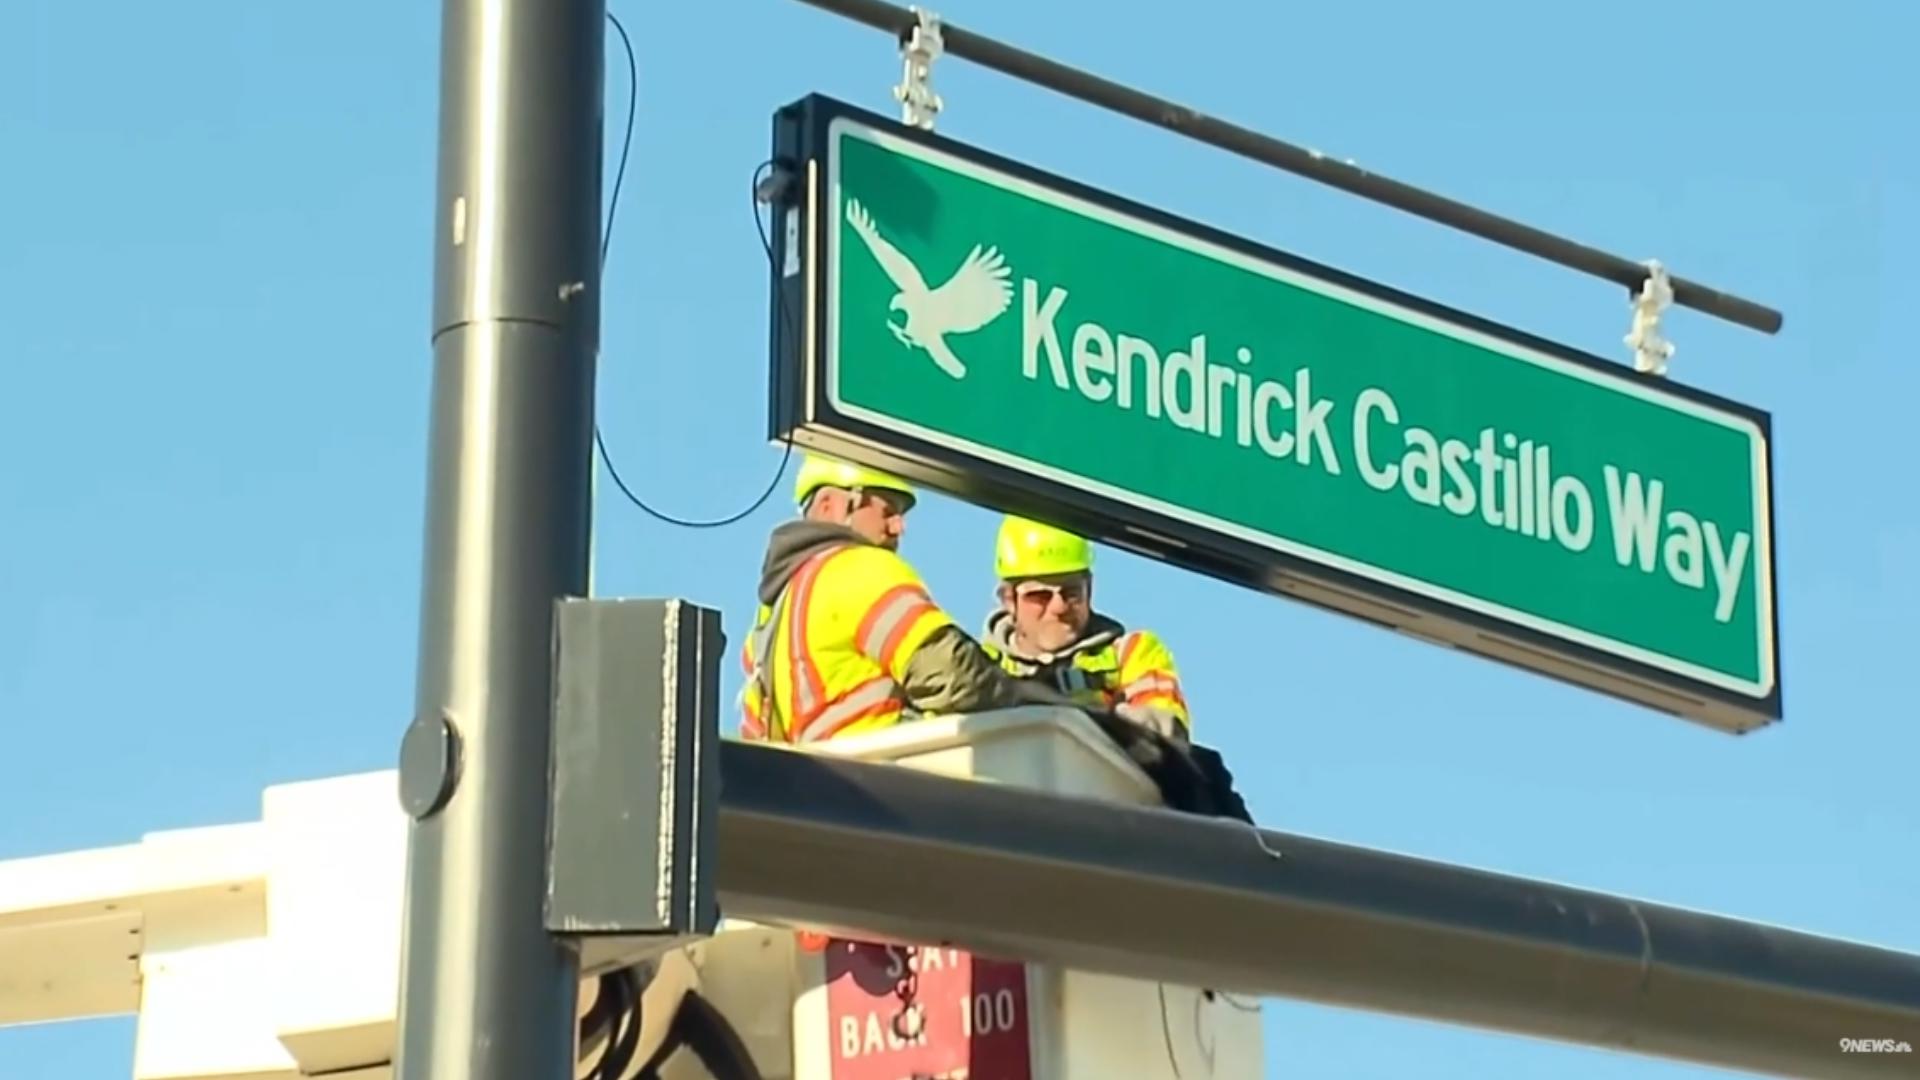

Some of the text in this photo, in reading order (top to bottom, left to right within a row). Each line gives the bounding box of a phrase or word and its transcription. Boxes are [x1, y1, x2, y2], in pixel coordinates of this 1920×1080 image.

[1022, 277, 1752, 624] Kendrick Castillo Way
[959, 989, 1015, 1038] 100
